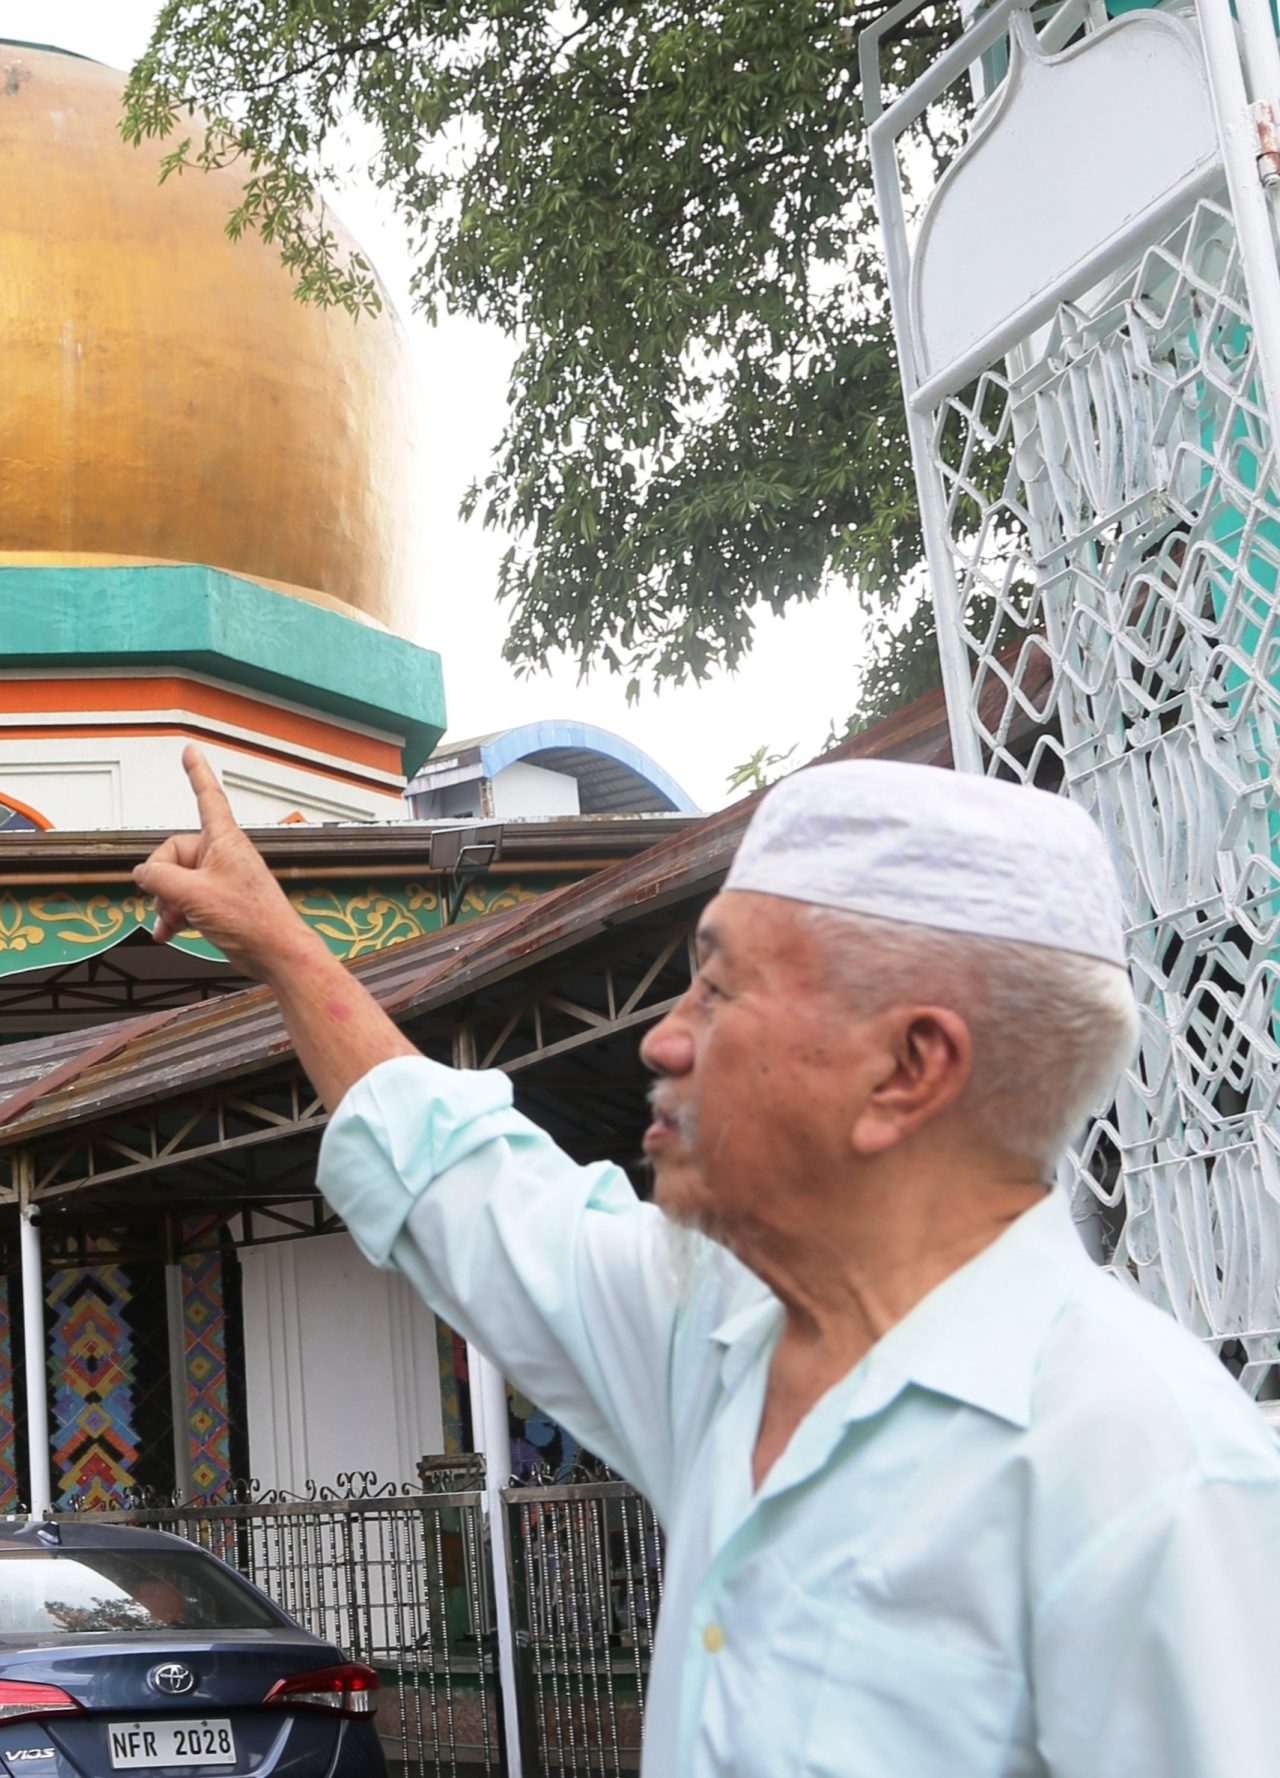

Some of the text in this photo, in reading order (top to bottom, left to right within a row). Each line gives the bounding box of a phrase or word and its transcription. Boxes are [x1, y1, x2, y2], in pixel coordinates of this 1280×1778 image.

[5, 1747, 55, 1761] VIOS
[113, 1729, 231, 1758] NFR 2028
